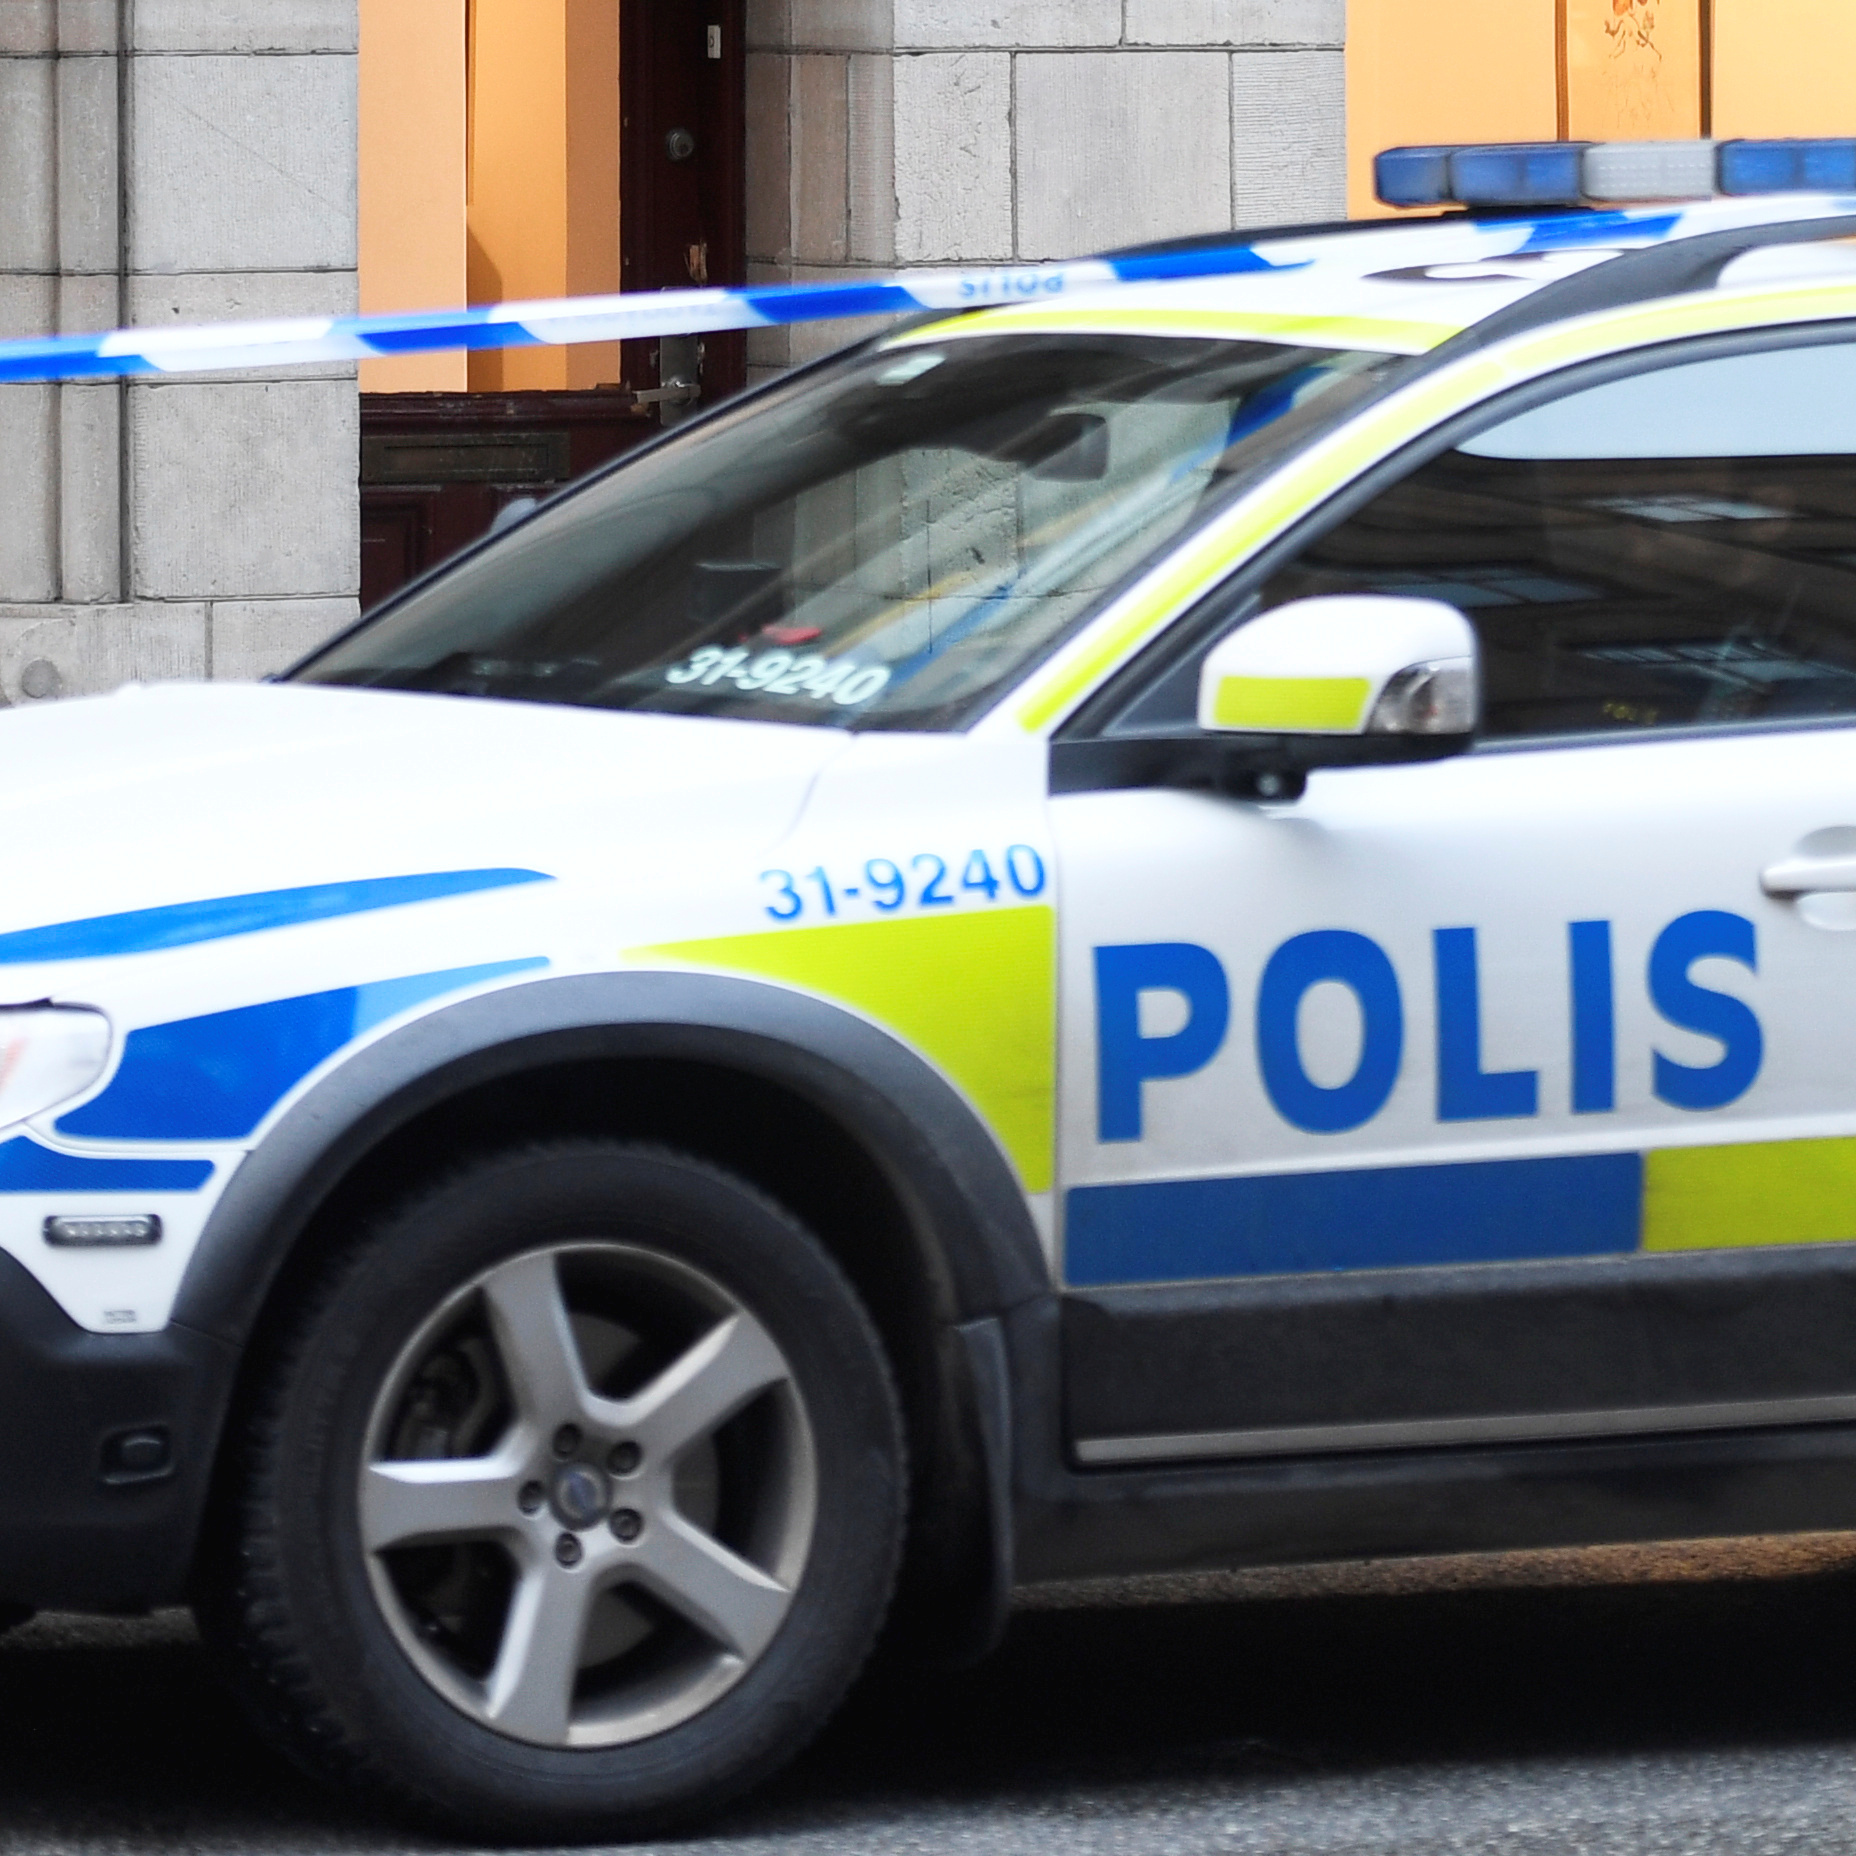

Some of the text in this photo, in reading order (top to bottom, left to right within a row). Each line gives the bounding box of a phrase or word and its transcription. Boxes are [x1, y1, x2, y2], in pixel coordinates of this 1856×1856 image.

[665, 646, 892, 706] 31-9240
[758, 843, 1046, 921] 31-9240
[1092, 909, 1766, 1145] POLIS
